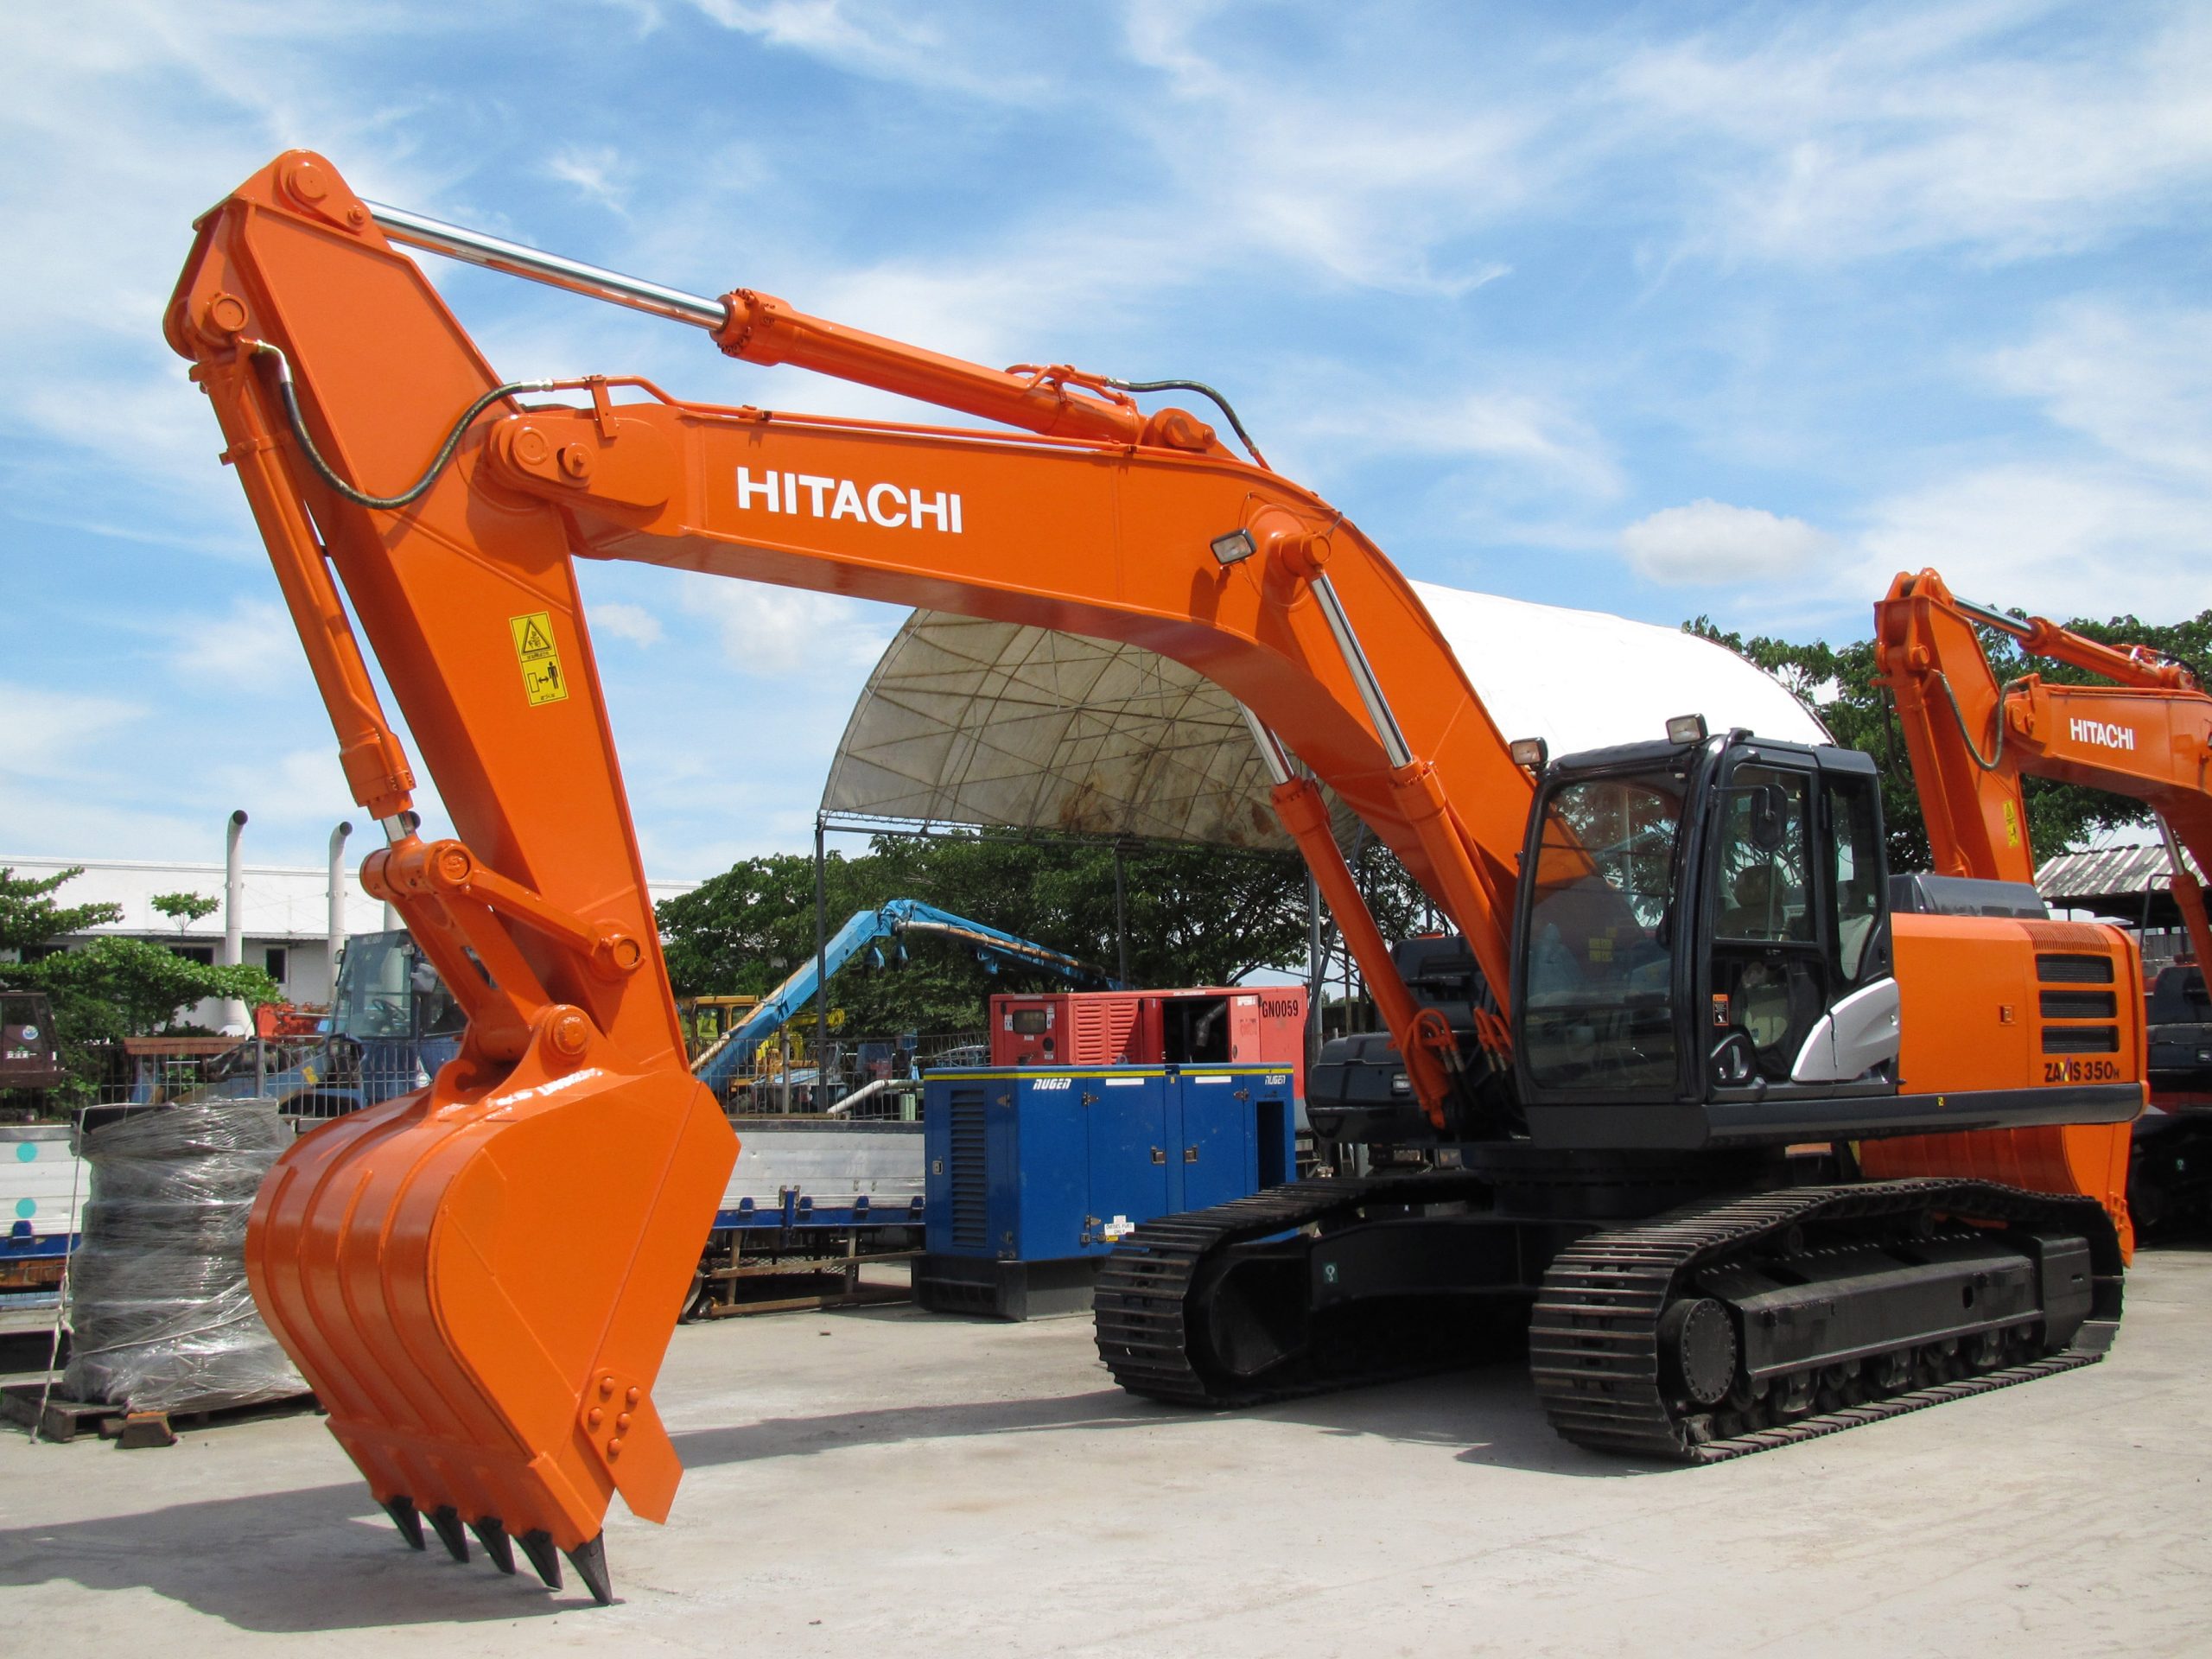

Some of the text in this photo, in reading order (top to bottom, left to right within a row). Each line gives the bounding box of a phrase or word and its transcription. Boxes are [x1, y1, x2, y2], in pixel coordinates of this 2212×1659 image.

[737, 466, 963, 534] HITACHI
[2069, 717, 2134, 751] HITACHI
[1262, 1000, 1299, 1018] GN0059
[2044, 1058, 2082, 1083] ZAXIS
[1033, 1077, 1071, 1090] NUGEN
